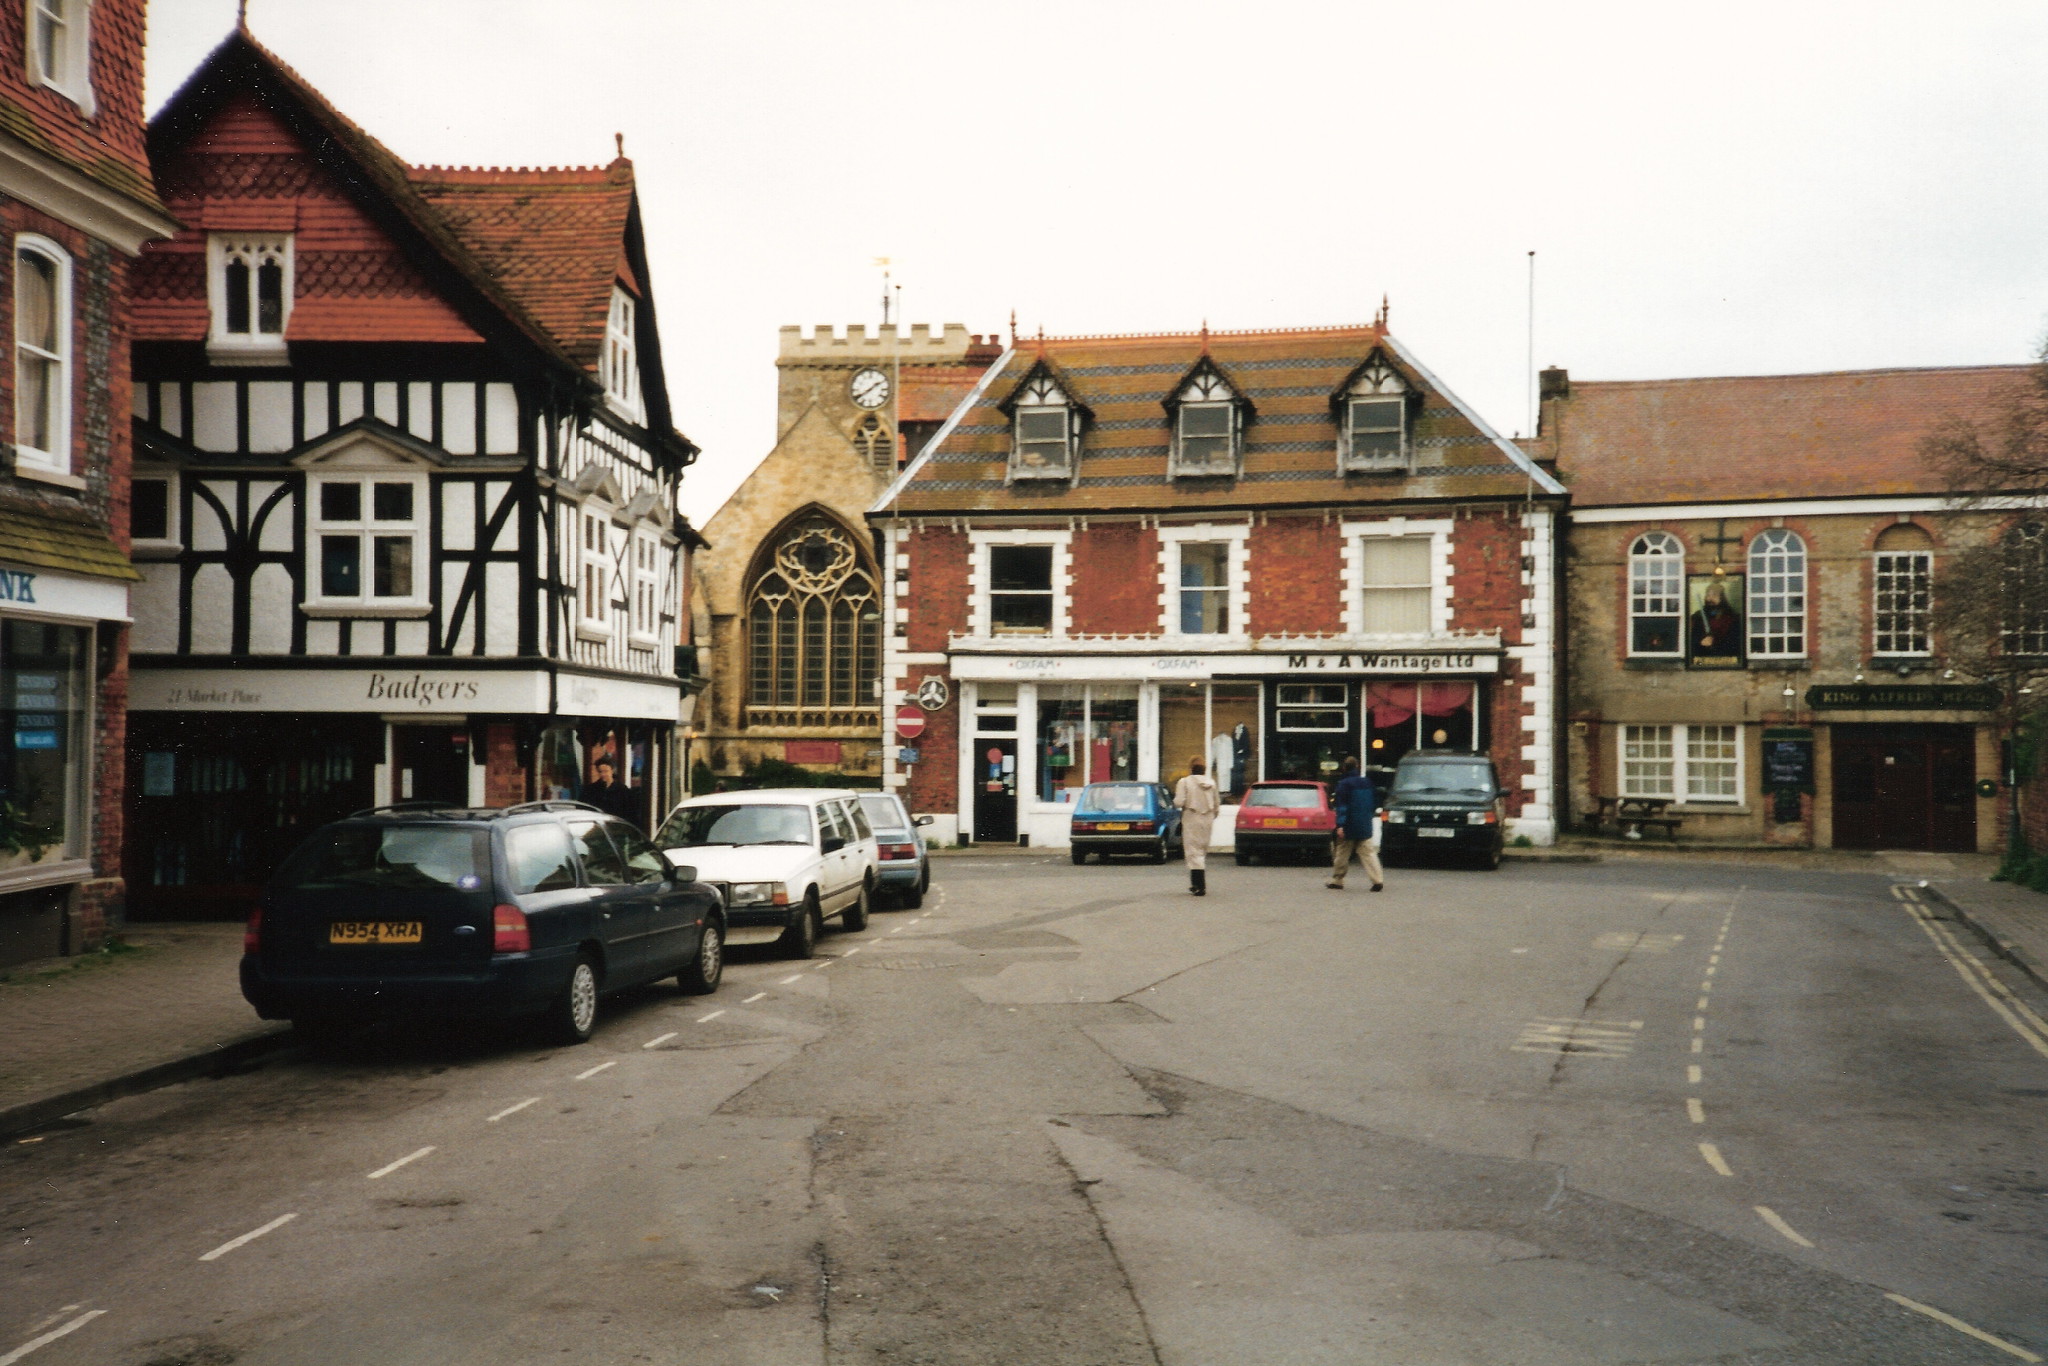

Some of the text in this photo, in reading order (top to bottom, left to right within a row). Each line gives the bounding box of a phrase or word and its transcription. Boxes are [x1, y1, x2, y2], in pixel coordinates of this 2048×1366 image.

[0, 568, 36, 603] NK
[1015, 660, 1055, 669] OXFAM
[1157, 659, 1198, 670] OXFAM
[1288, 655, 1474, 671] M & A Wantage Ltd
[187, 688, 227, 704] Market
[230, 689, 262, 704] Place
[367, 673, 479, 708] Badgers
[1823, 692, 1860, 703] KING
[333, 922, 419, 938] N954 XRA
